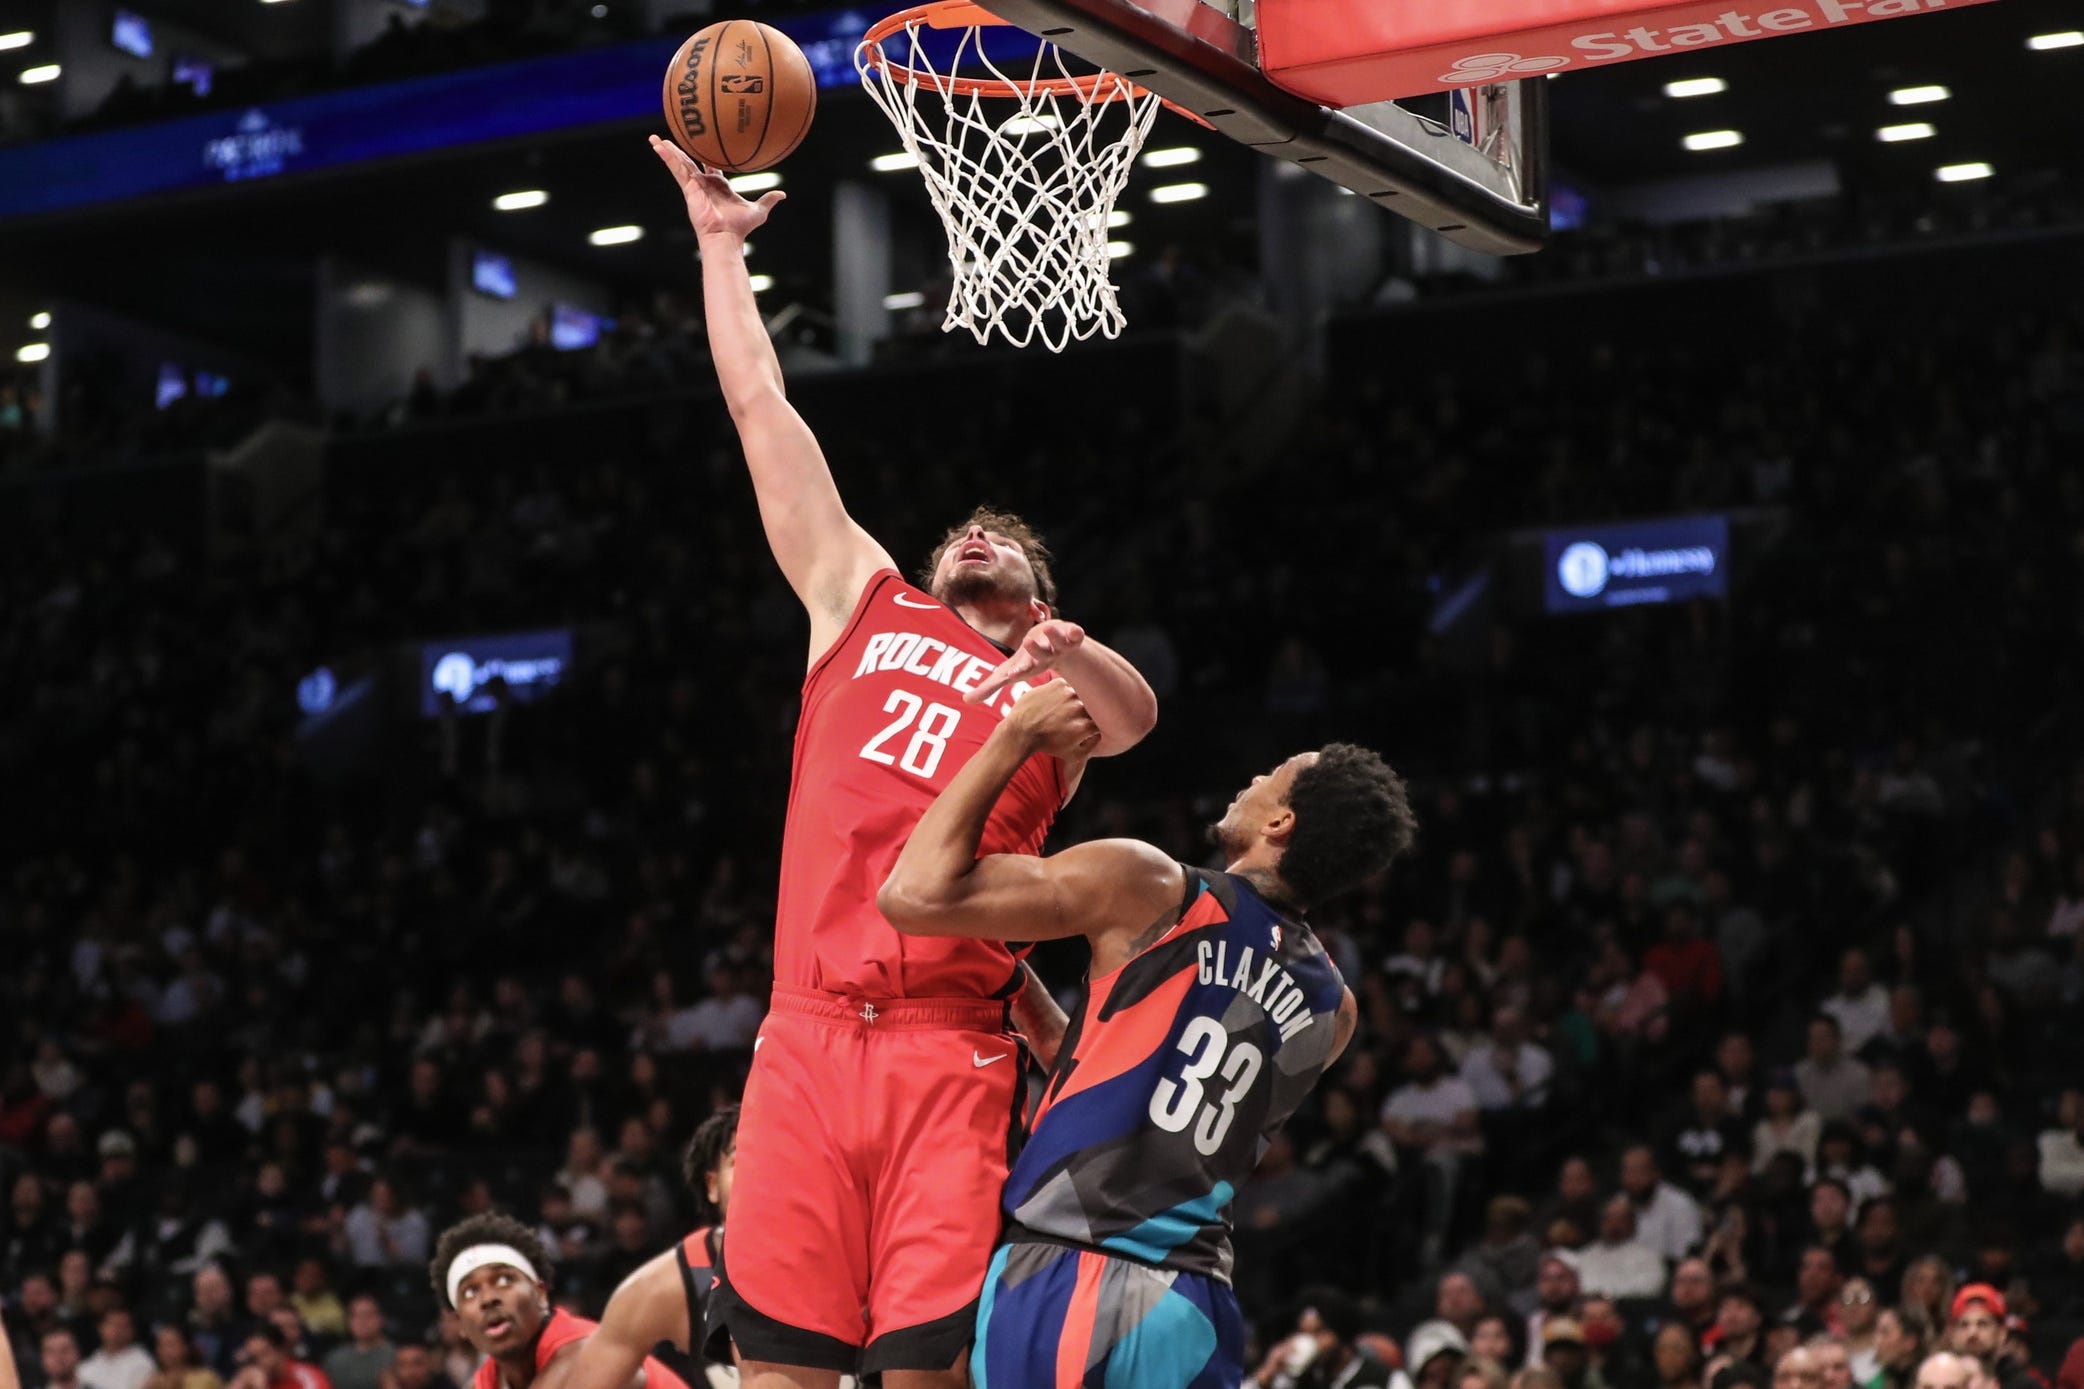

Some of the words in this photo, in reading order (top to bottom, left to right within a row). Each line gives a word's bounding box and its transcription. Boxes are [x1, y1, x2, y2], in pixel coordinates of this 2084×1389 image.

[1571, 8, 1812, 61] State
[1816, 0, 1947, 23] Fa
[678, 37, 711, 139] Wilson
[852, 632, 1033, 718] ROCKES
[858, 689, 961, 779] 28
[1198, 940, 1314, 1043] CLAXTON
[1149, 1016, 1263, 1156] 33
